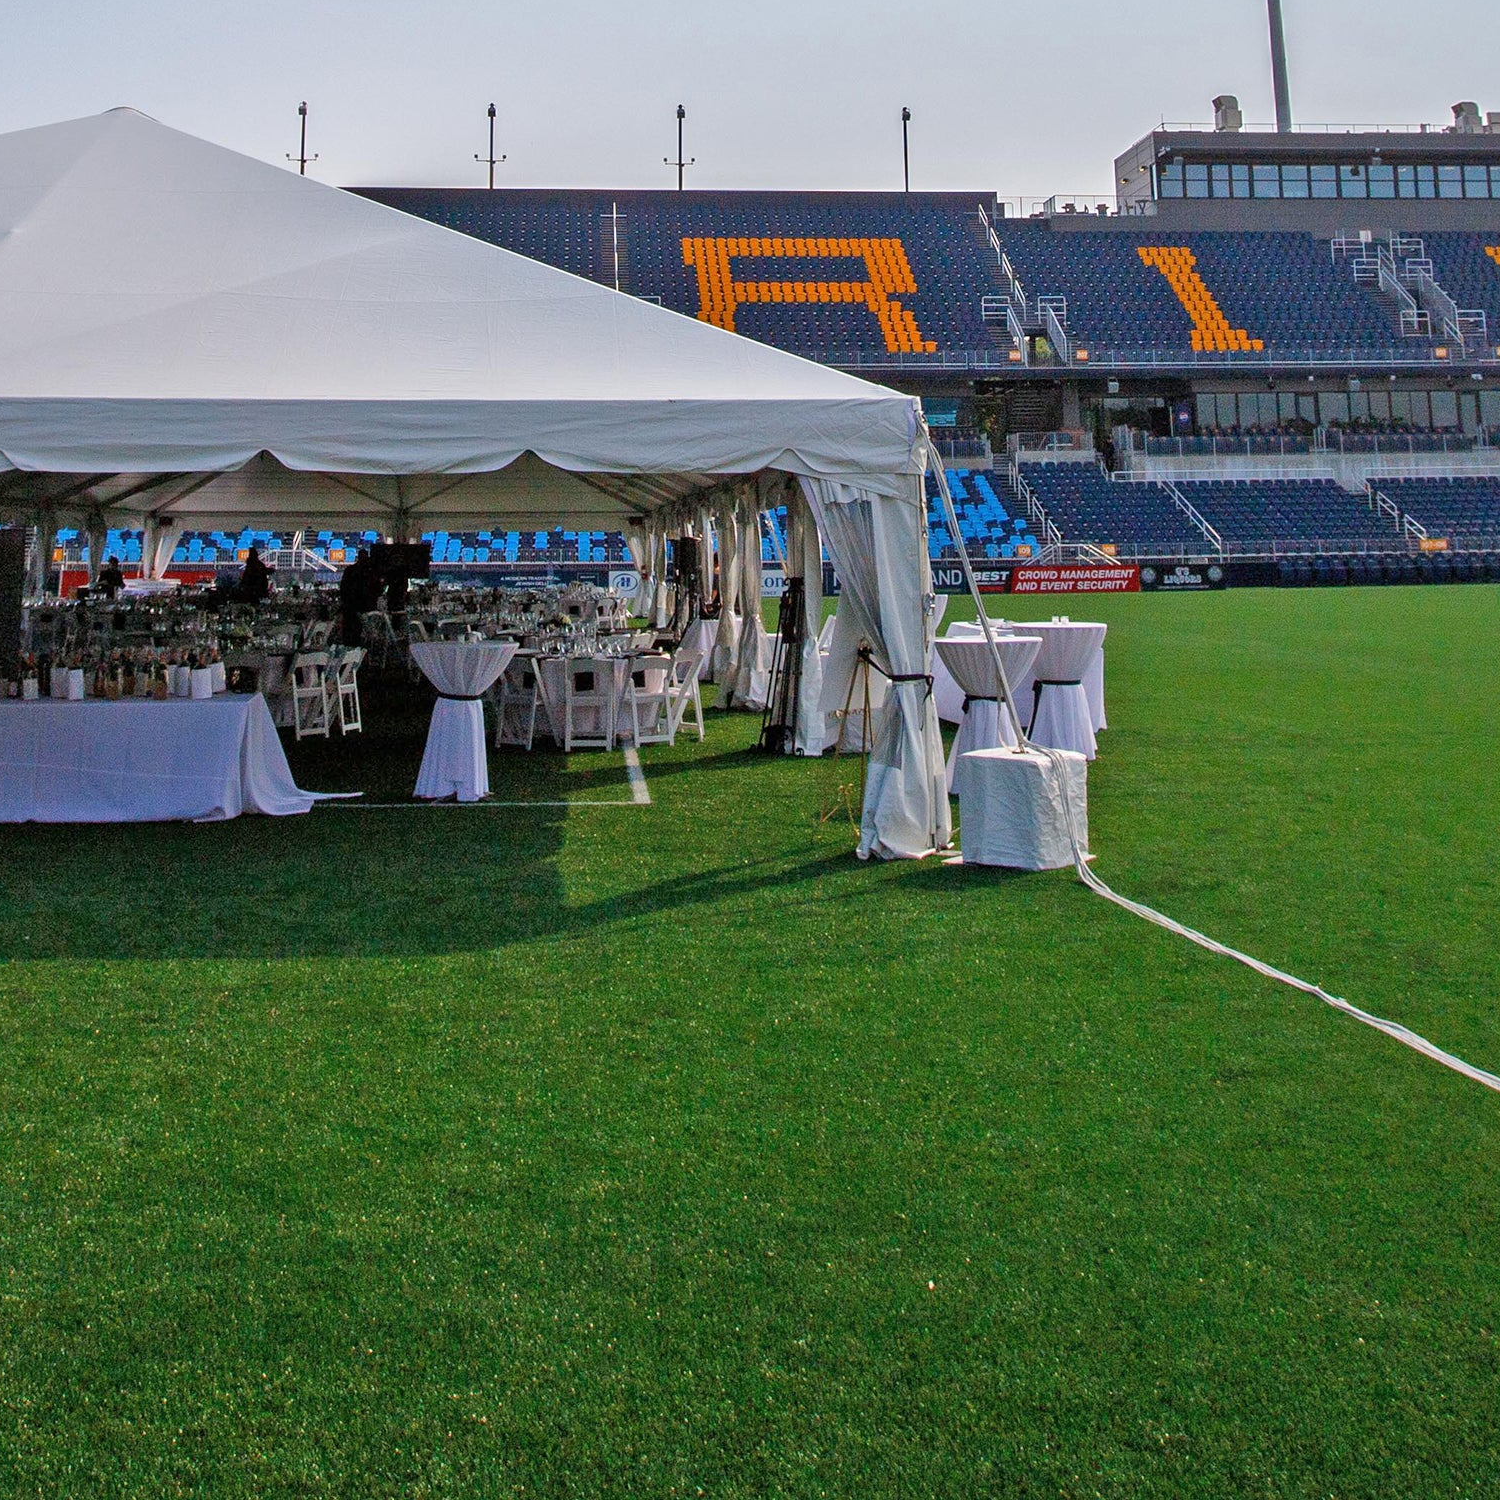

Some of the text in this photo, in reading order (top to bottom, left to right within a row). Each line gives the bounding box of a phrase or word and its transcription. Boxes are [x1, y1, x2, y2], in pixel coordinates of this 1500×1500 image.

[683, 238, 937, 353] R
[1138, 247, 1264, 351] I
[973, 571, 1009, 581] BEST
[1018, 568, 1135, 580] CROWD MANAGEMENT
[1015, 581, 1038, 592] AND
[1039, 581, 1074, 591] EVENT
[1076, 579, 1128, 590] SECURITY
